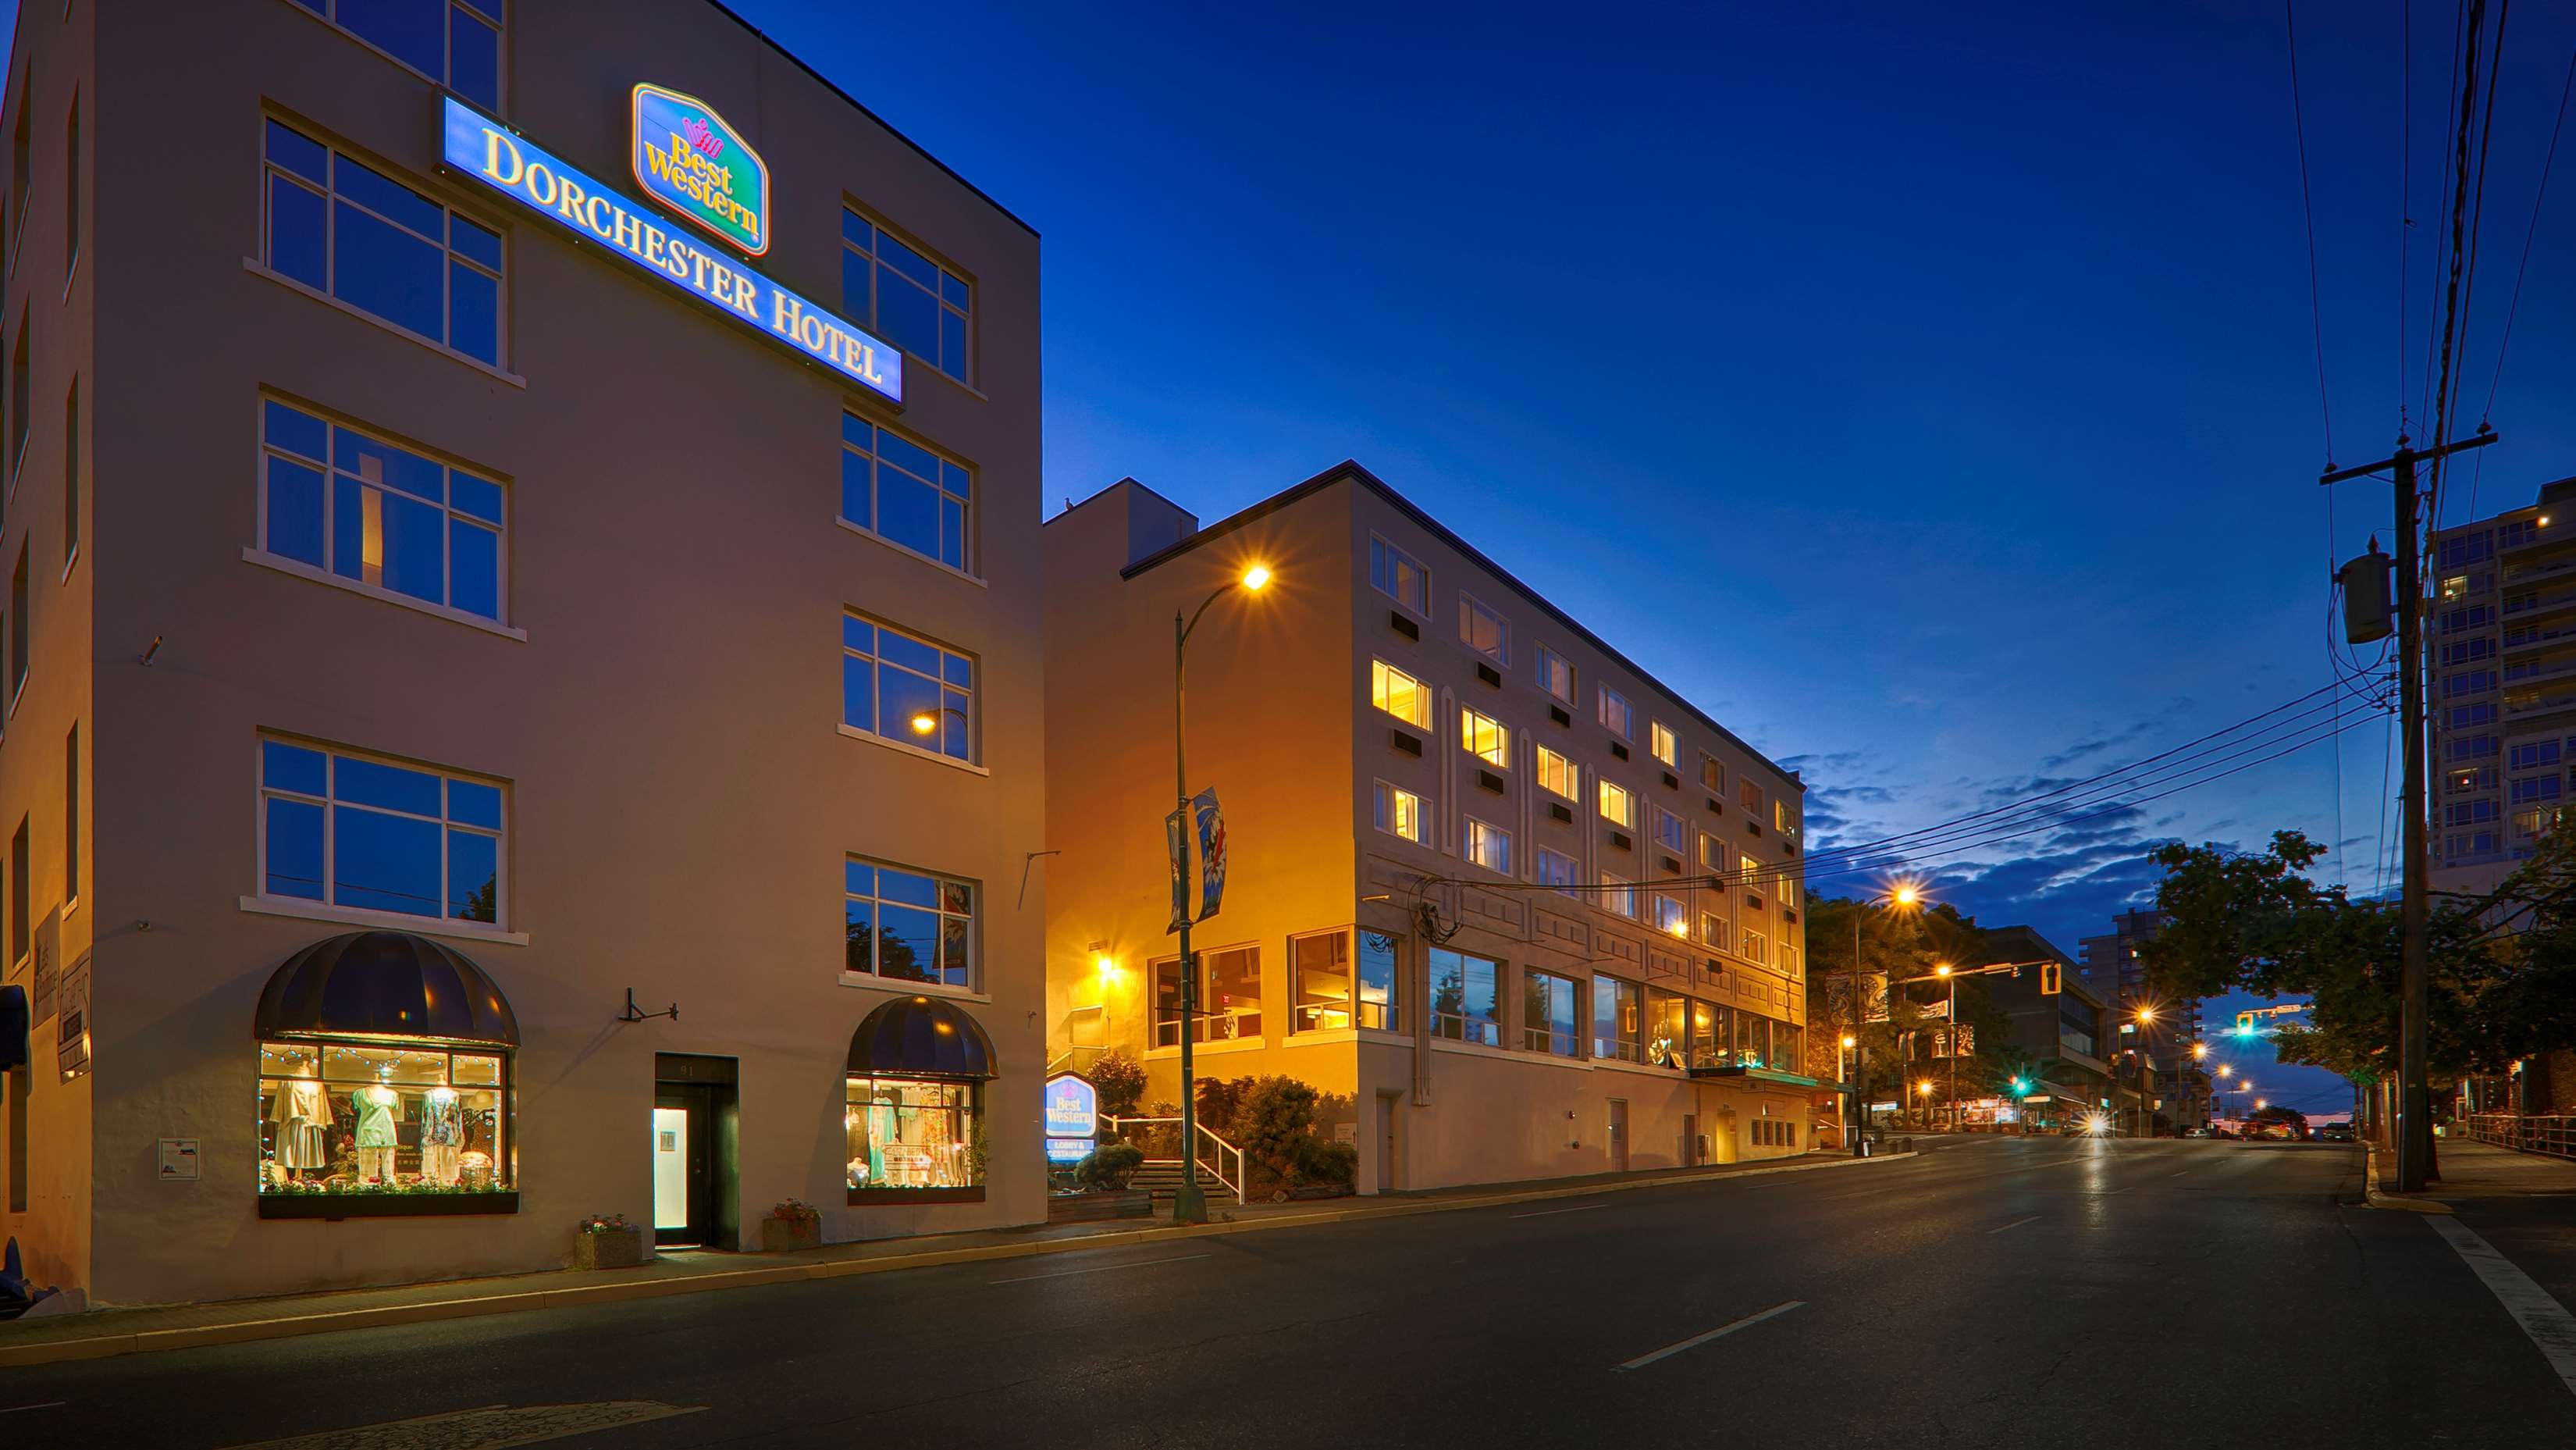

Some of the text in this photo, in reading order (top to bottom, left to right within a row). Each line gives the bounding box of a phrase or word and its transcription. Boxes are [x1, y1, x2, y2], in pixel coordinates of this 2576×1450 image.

[644, 141, 760, 237] Western
[670, 132, 734, 196] Best
[481, 127, 883, 385] DORCHESTER HOTEL
[1047, 1108, 1091, 1124] Western
[1056, 1096, 1081, 1111] Best
